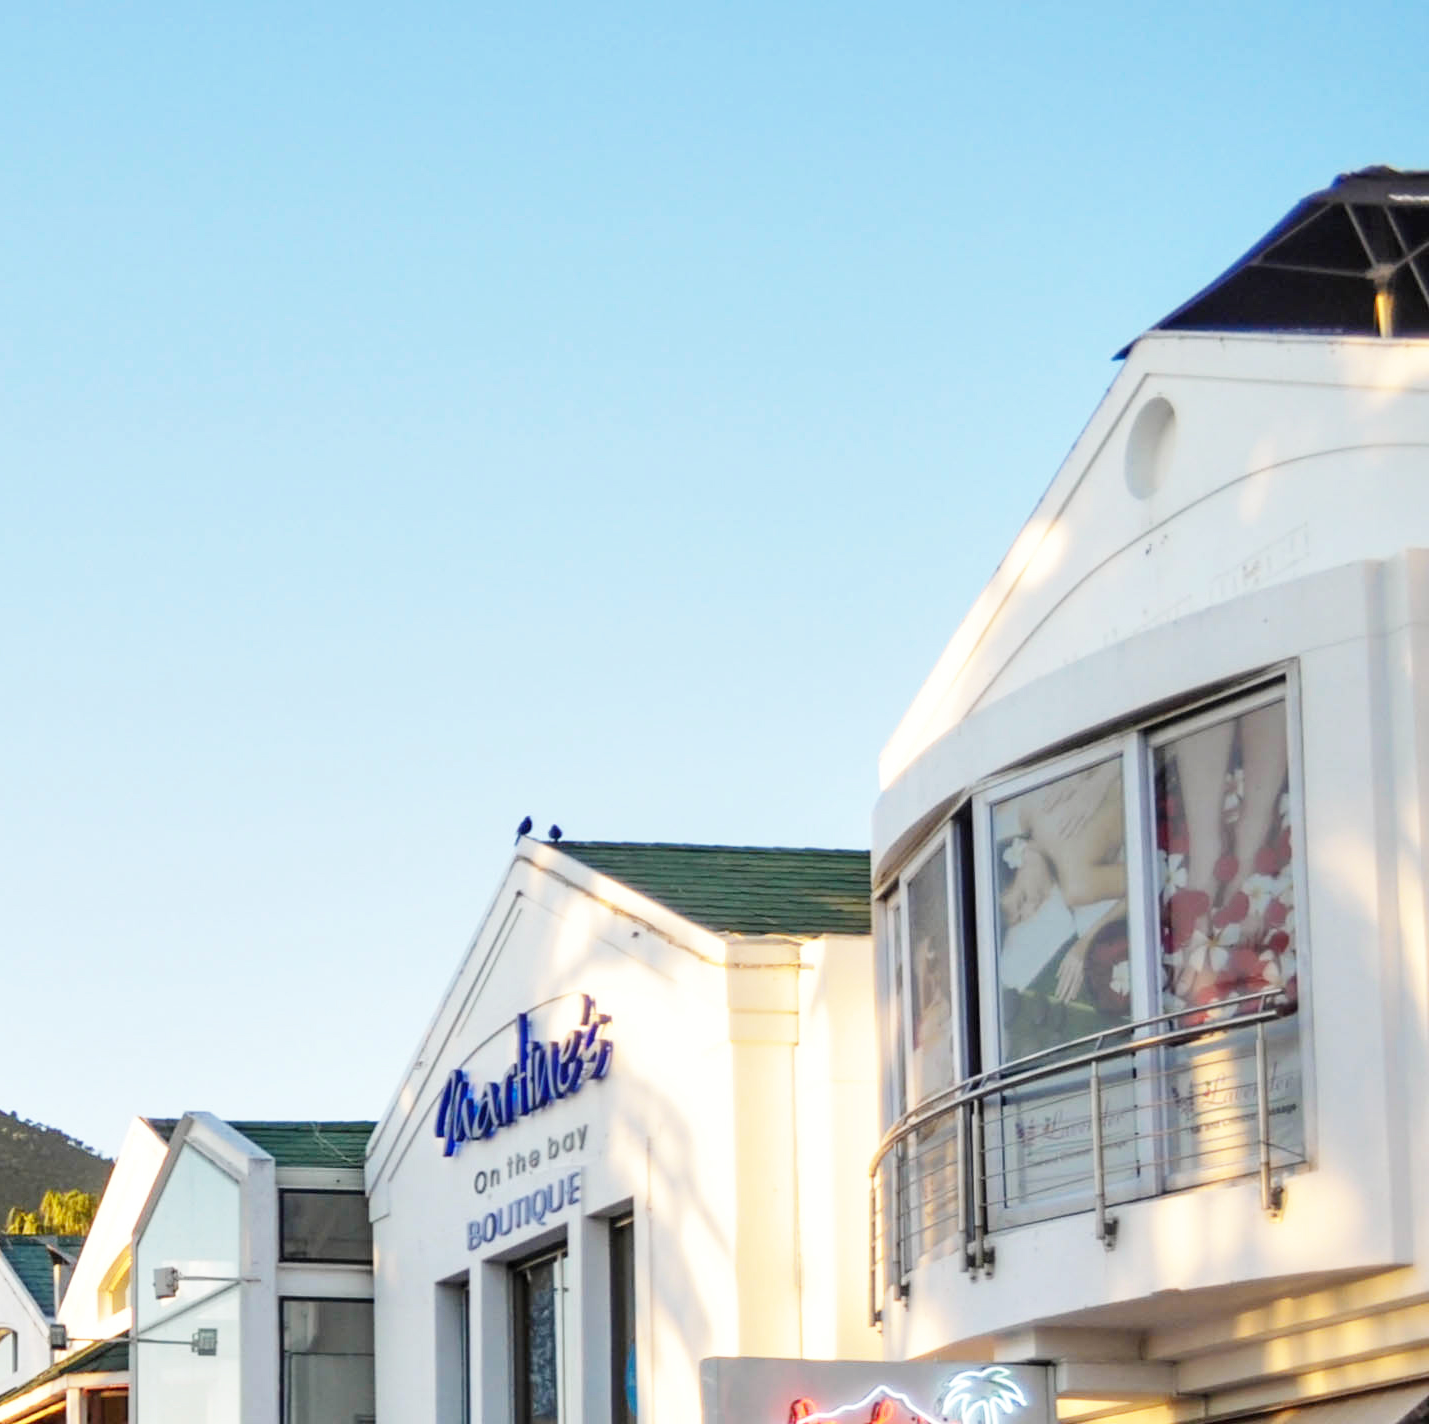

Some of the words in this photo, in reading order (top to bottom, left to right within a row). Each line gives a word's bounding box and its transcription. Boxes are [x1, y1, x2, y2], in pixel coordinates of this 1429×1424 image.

[474, 1169, 501, 1194] On
[507, 1150, 540, 1179] the
[548, 1124, 588, 1160] bay
[468, 1171, 581, 1251] BOUTIQUE
